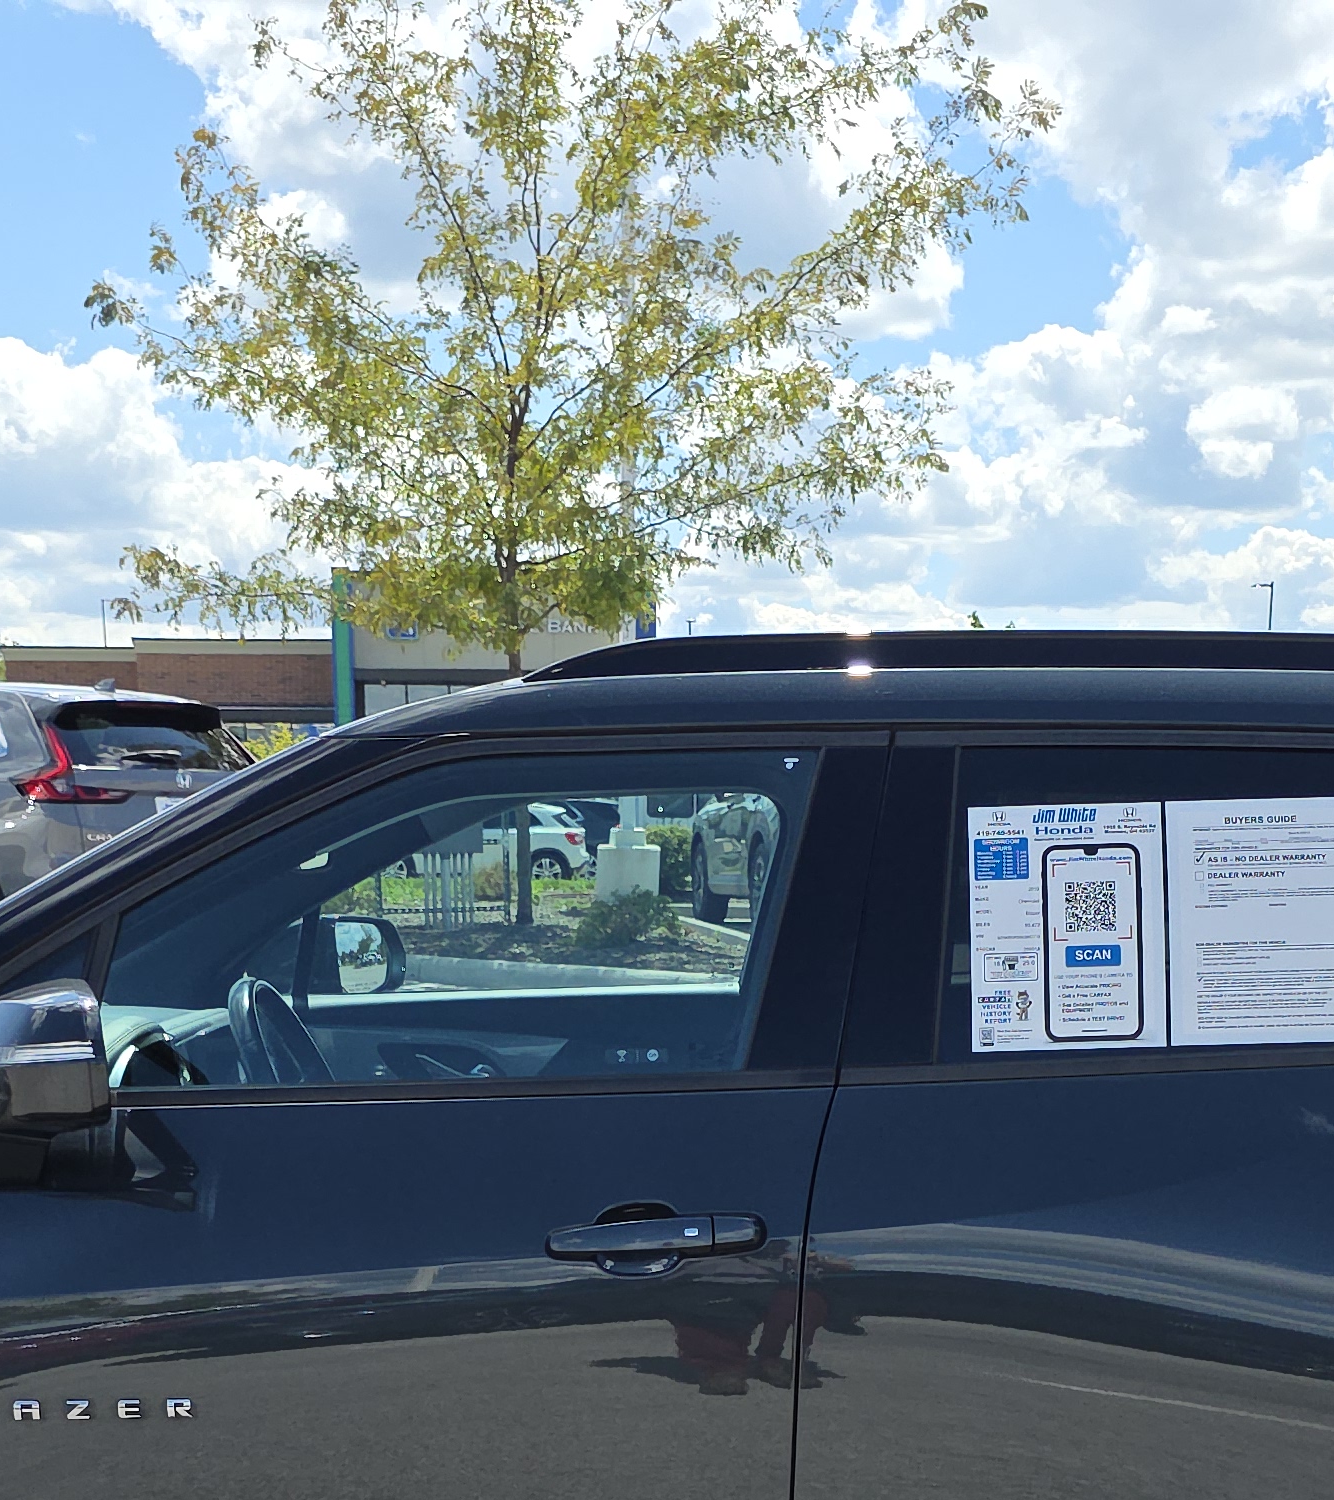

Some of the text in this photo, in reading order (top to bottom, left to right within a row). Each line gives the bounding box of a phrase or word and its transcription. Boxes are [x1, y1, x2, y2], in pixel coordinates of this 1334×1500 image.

[1032, 807, 1097, 824] Jim White
[1224, 815, 1297, 825] BUYERS GUIDE
[1035, 825, 1094, 835] Honda
[1234, 855, 1247, 863] NO
[1248, 854, 1280, 862] DEALER
[1282, 853, 1327, 861] WARRANTY
[1207, 870, 1286, 880] DEALER WARRANTY
[1075, 949, 1111, 960] SCAN
